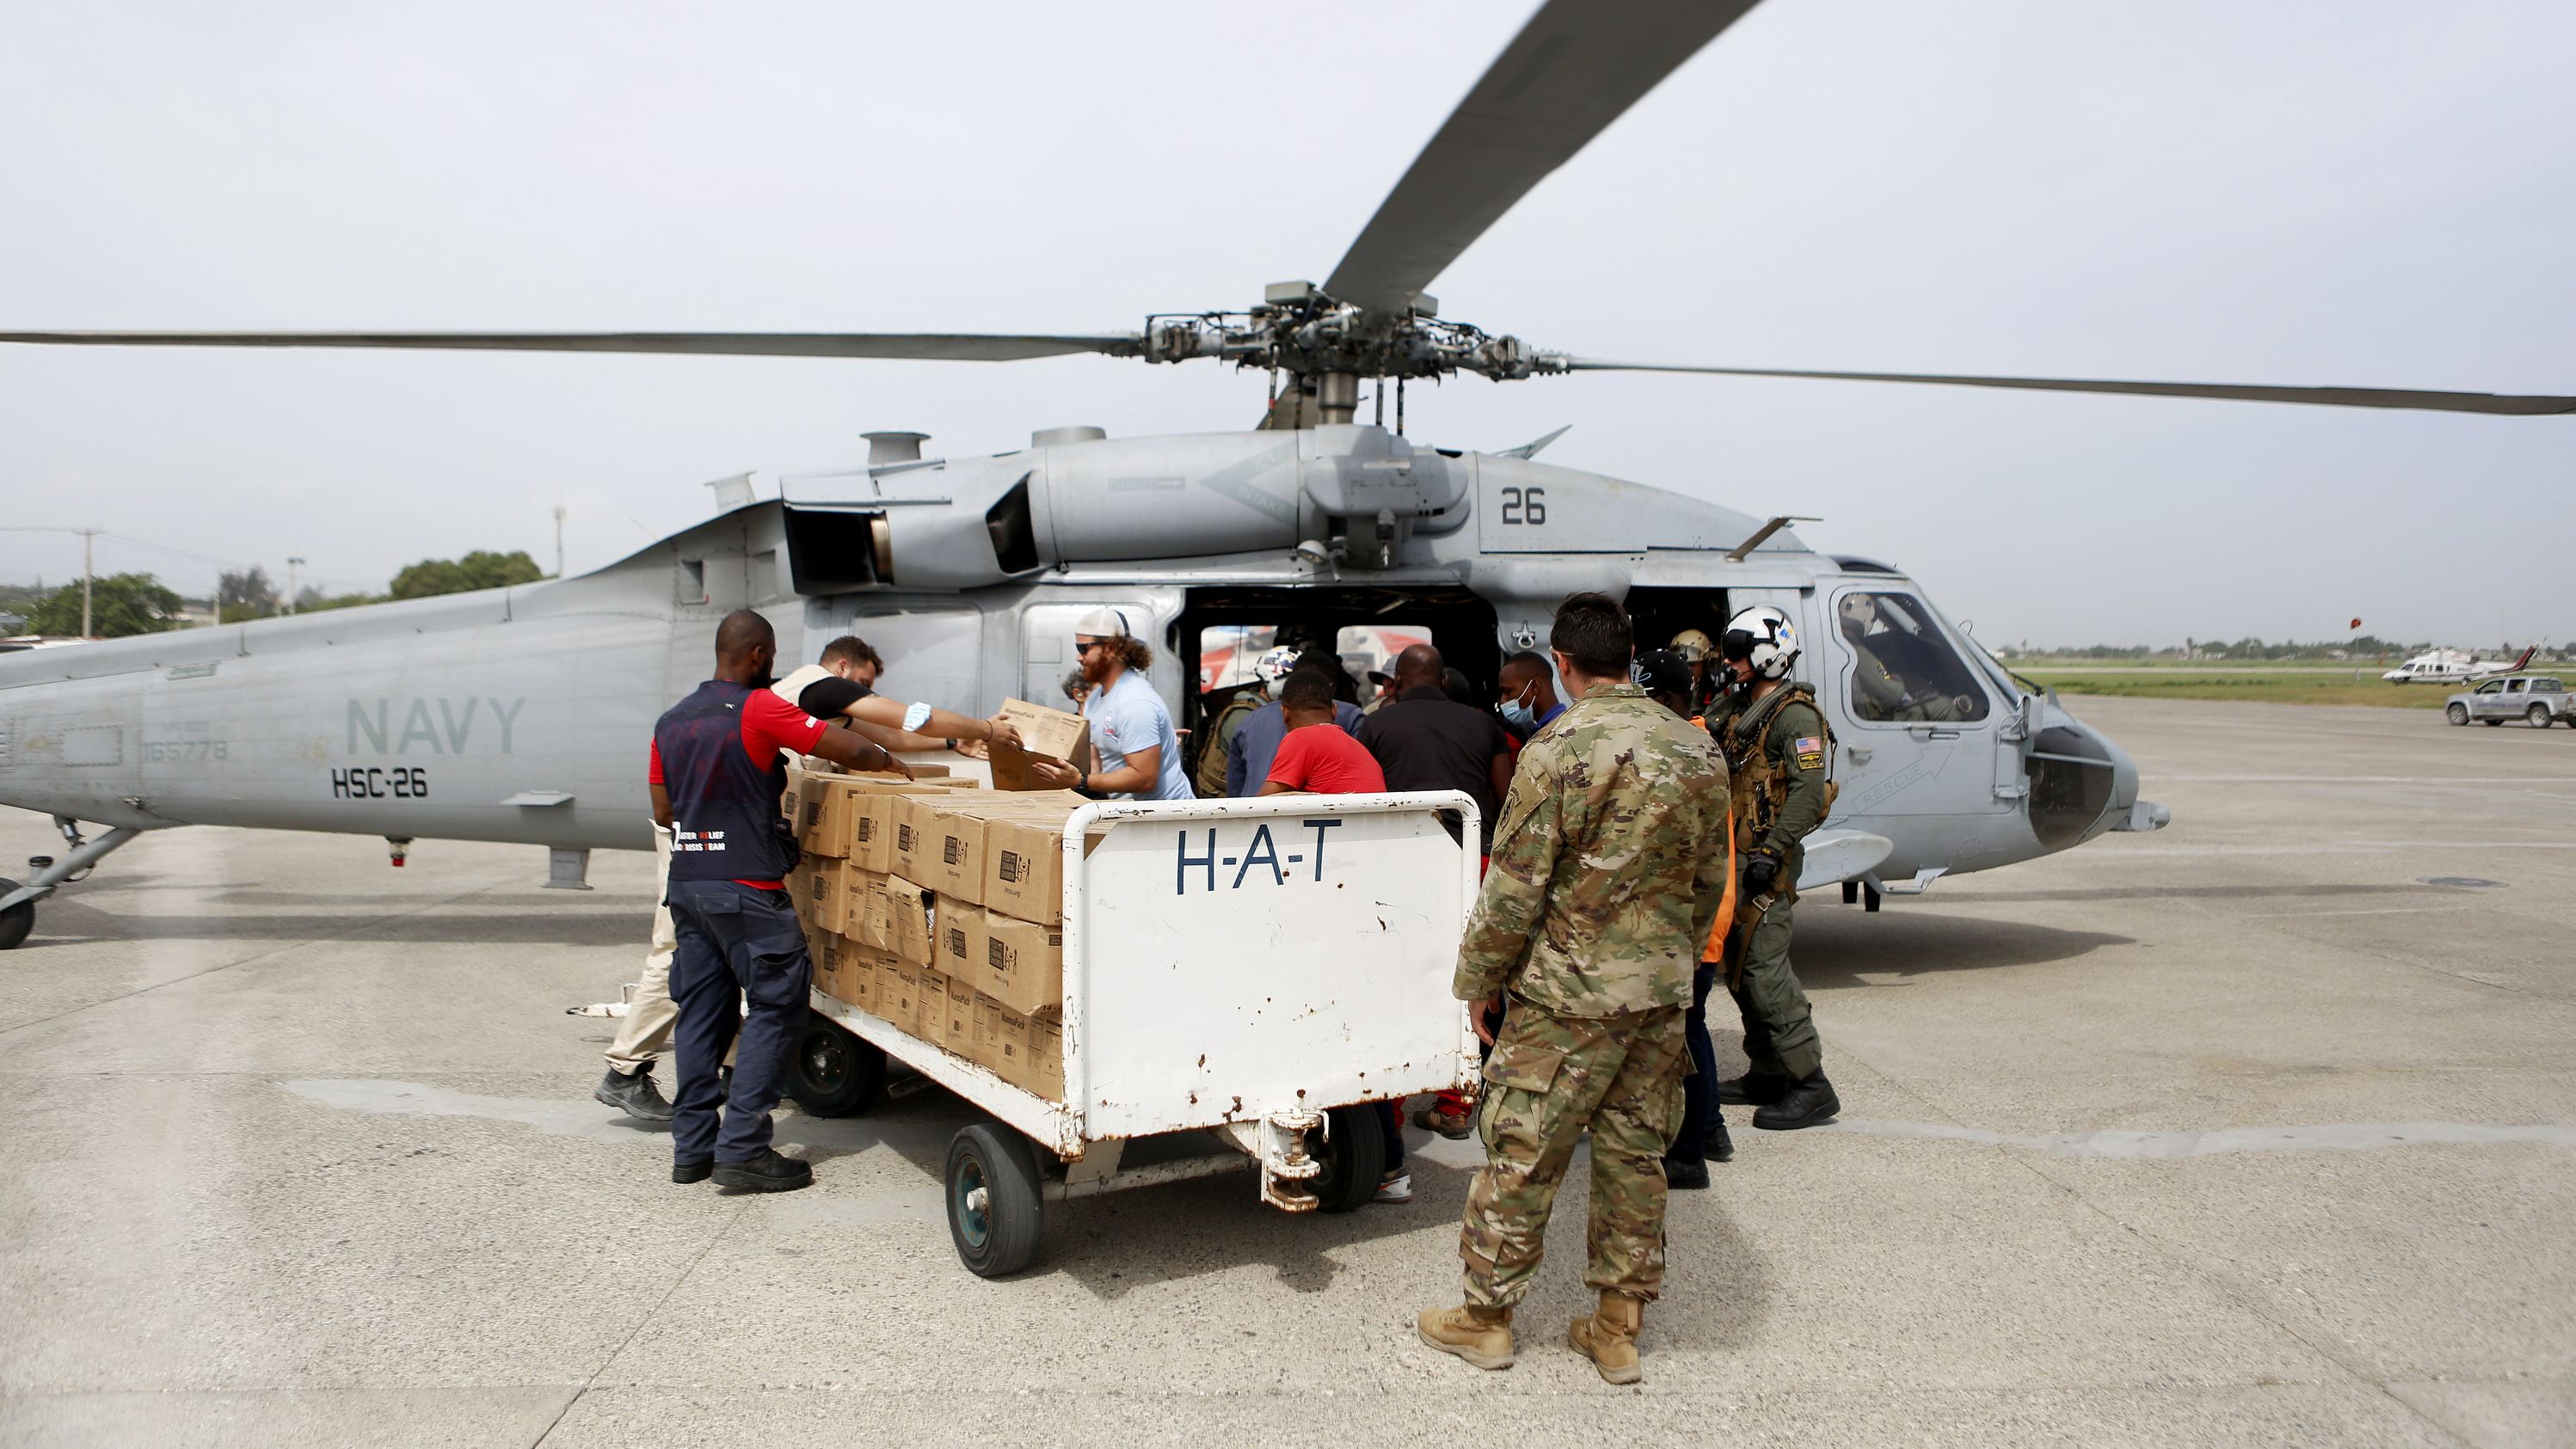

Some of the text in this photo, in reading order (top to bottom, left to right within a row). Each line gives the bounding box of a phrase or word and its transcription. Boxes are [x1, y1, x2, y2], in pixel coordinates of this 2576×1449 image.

[1239, 486, 1288, 515] INTAKE
[1502, 487, 1546, 525] 26
[347, 697, 526, 755] NAVY
[1004, 708, 1036, 719] MannaPack
[143, 740, 228, 761] 165778
[331, 767, 429, 799] HSC-26
[1862, 764, 1922, 806] RESCUE
[699, 831, 725, 840] RELIEF
[704, 842, 726, 851] TEAM
[1177, 820, 1342, 895] H-A-T
[1001, 1012, 1025, 1030] MannaPack
